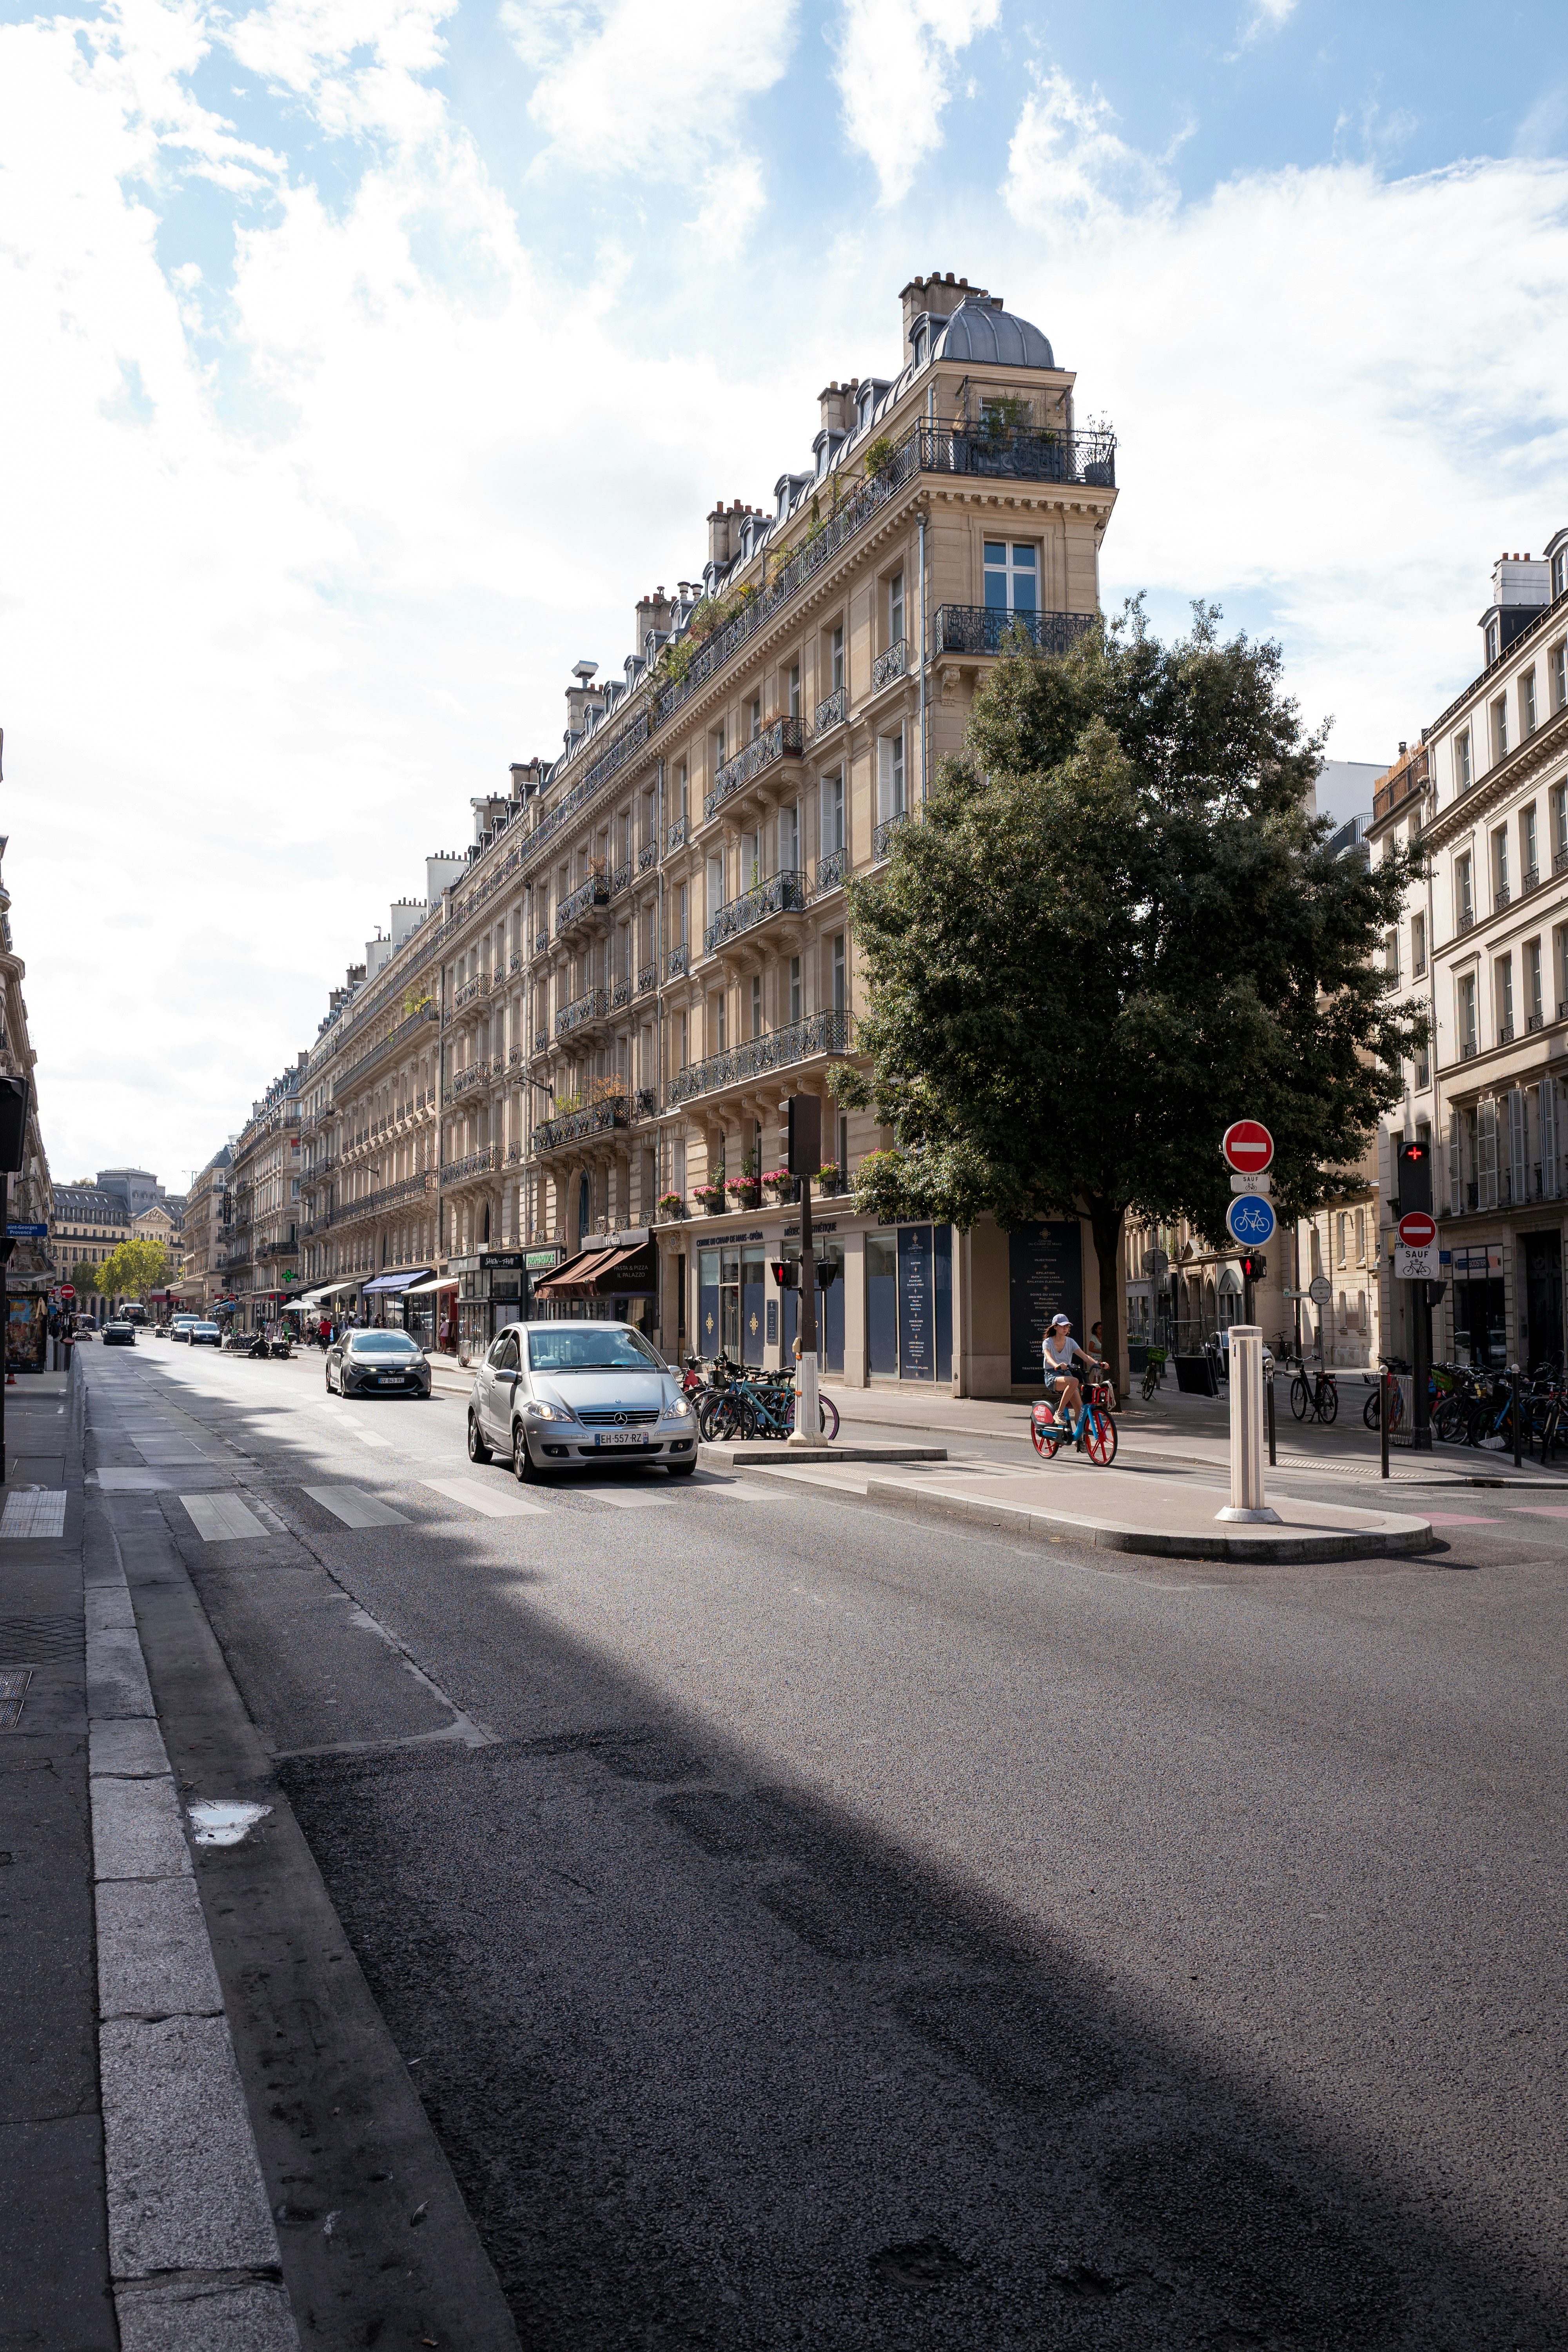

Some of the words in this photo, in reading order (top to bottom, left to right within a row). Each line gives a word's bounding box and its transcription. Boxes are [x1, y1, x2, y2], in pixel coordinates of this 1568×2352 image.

[696, 1238, 710, 1247] CENTRE
[716, 1236, 730, 1245] CHAMP
[735, 1234, 747, 1242] MARS
[749, 1230, 764, 1240] OPÉRA
[528, 1253, 554, 1265] PARAPHARMACIE
[1469, 1259, 1486, 1267] BOOSTER
[601, 1434, 642, 1444] EH-557-RZ
